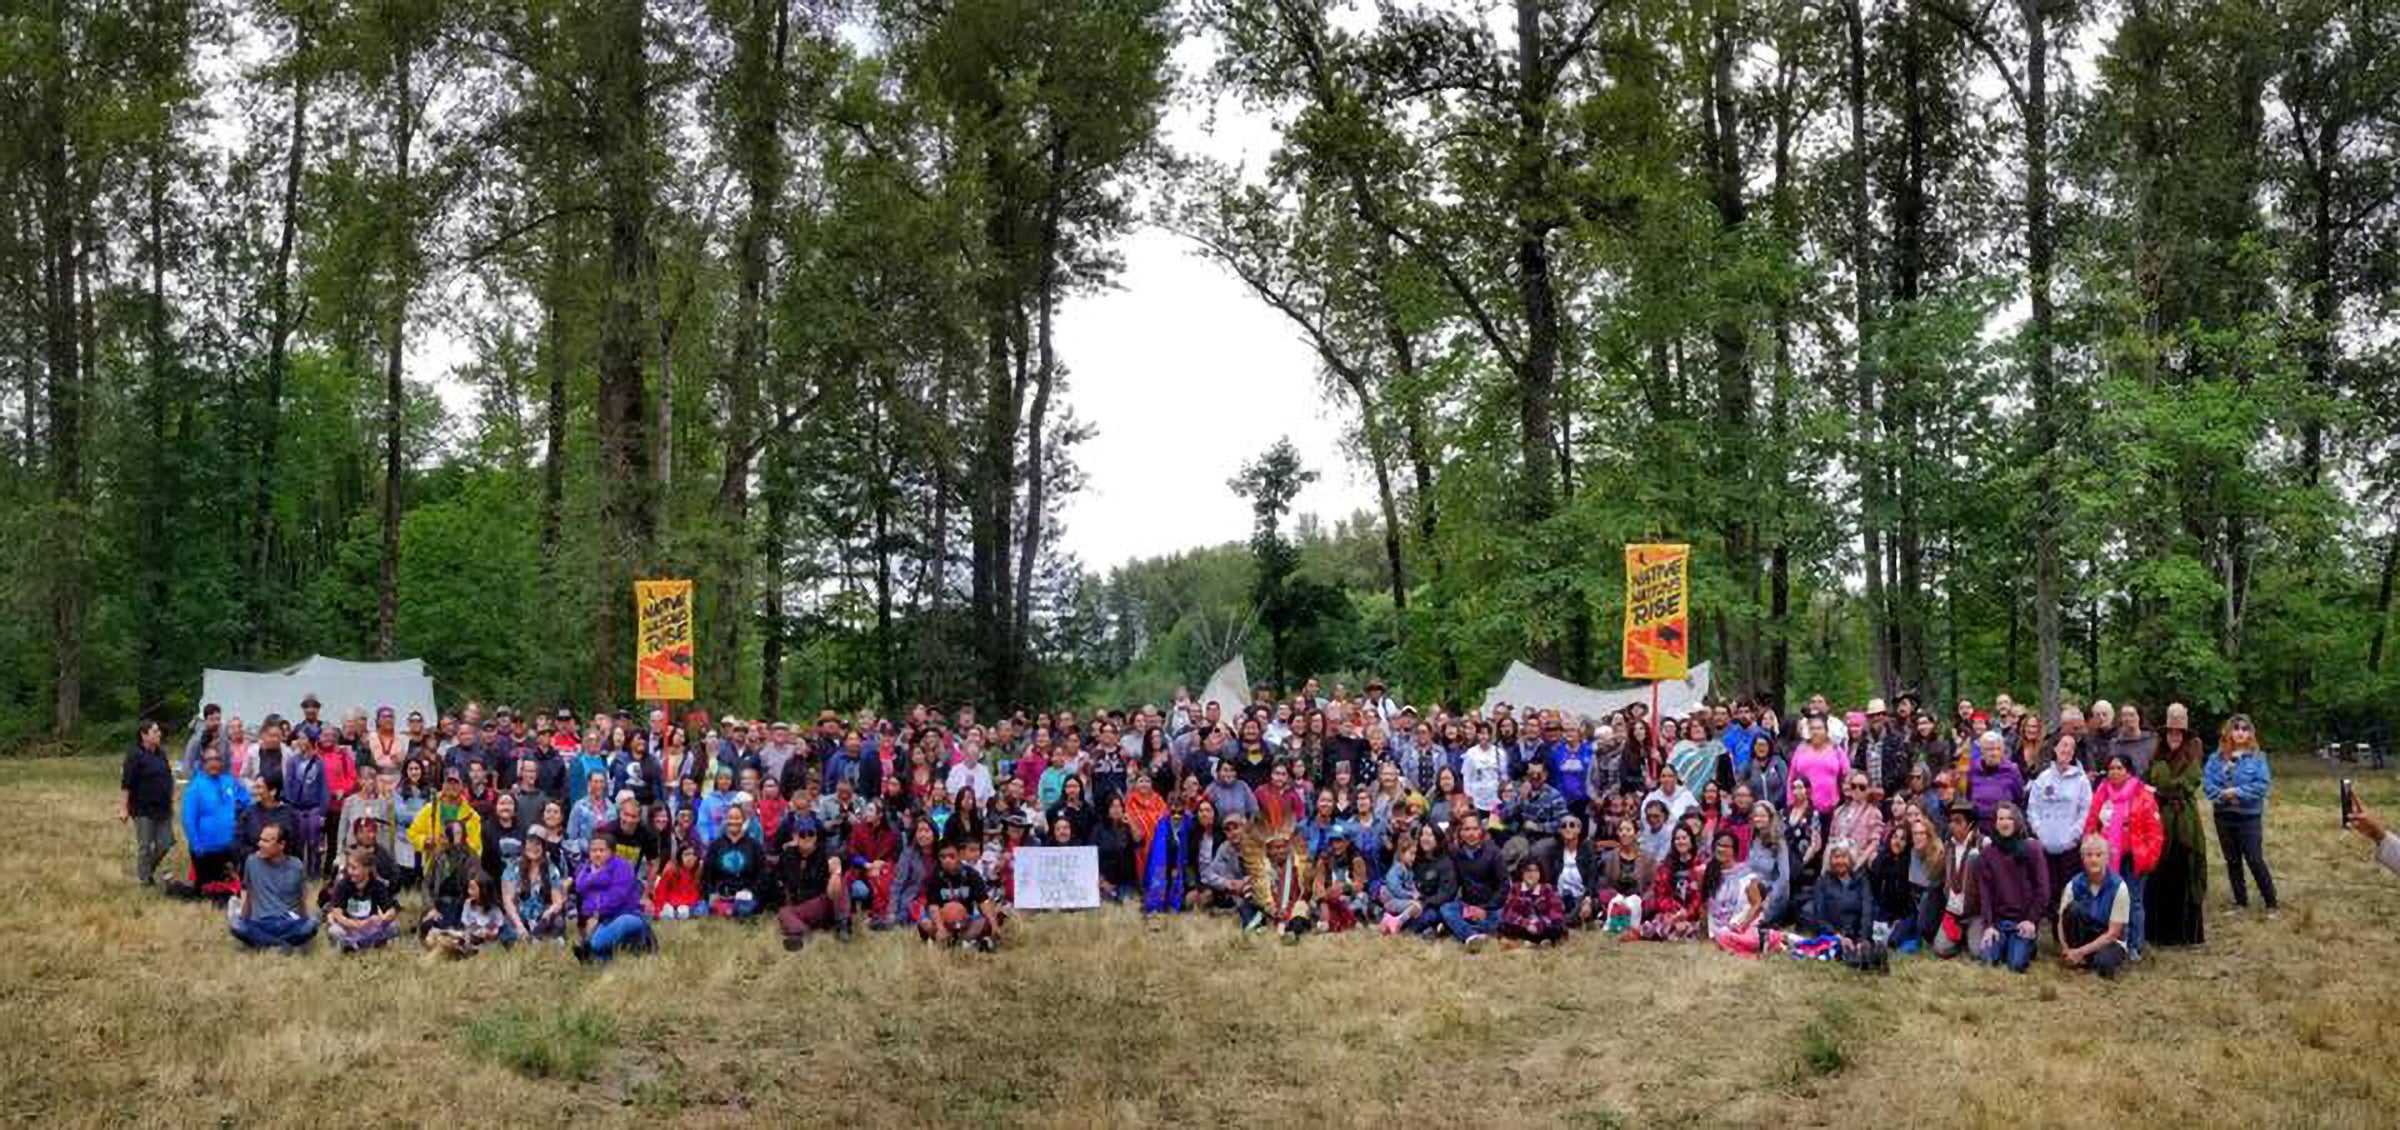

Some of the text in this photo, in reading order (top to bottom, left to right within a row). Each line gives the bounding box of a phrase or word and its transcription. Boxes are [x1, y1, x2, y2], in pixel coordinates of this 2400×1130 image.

[1633, 561, 1681, 584] NATIVE
[1634, 594, 1680, 625] RISE
[645, 622, 687, 651] RISE
